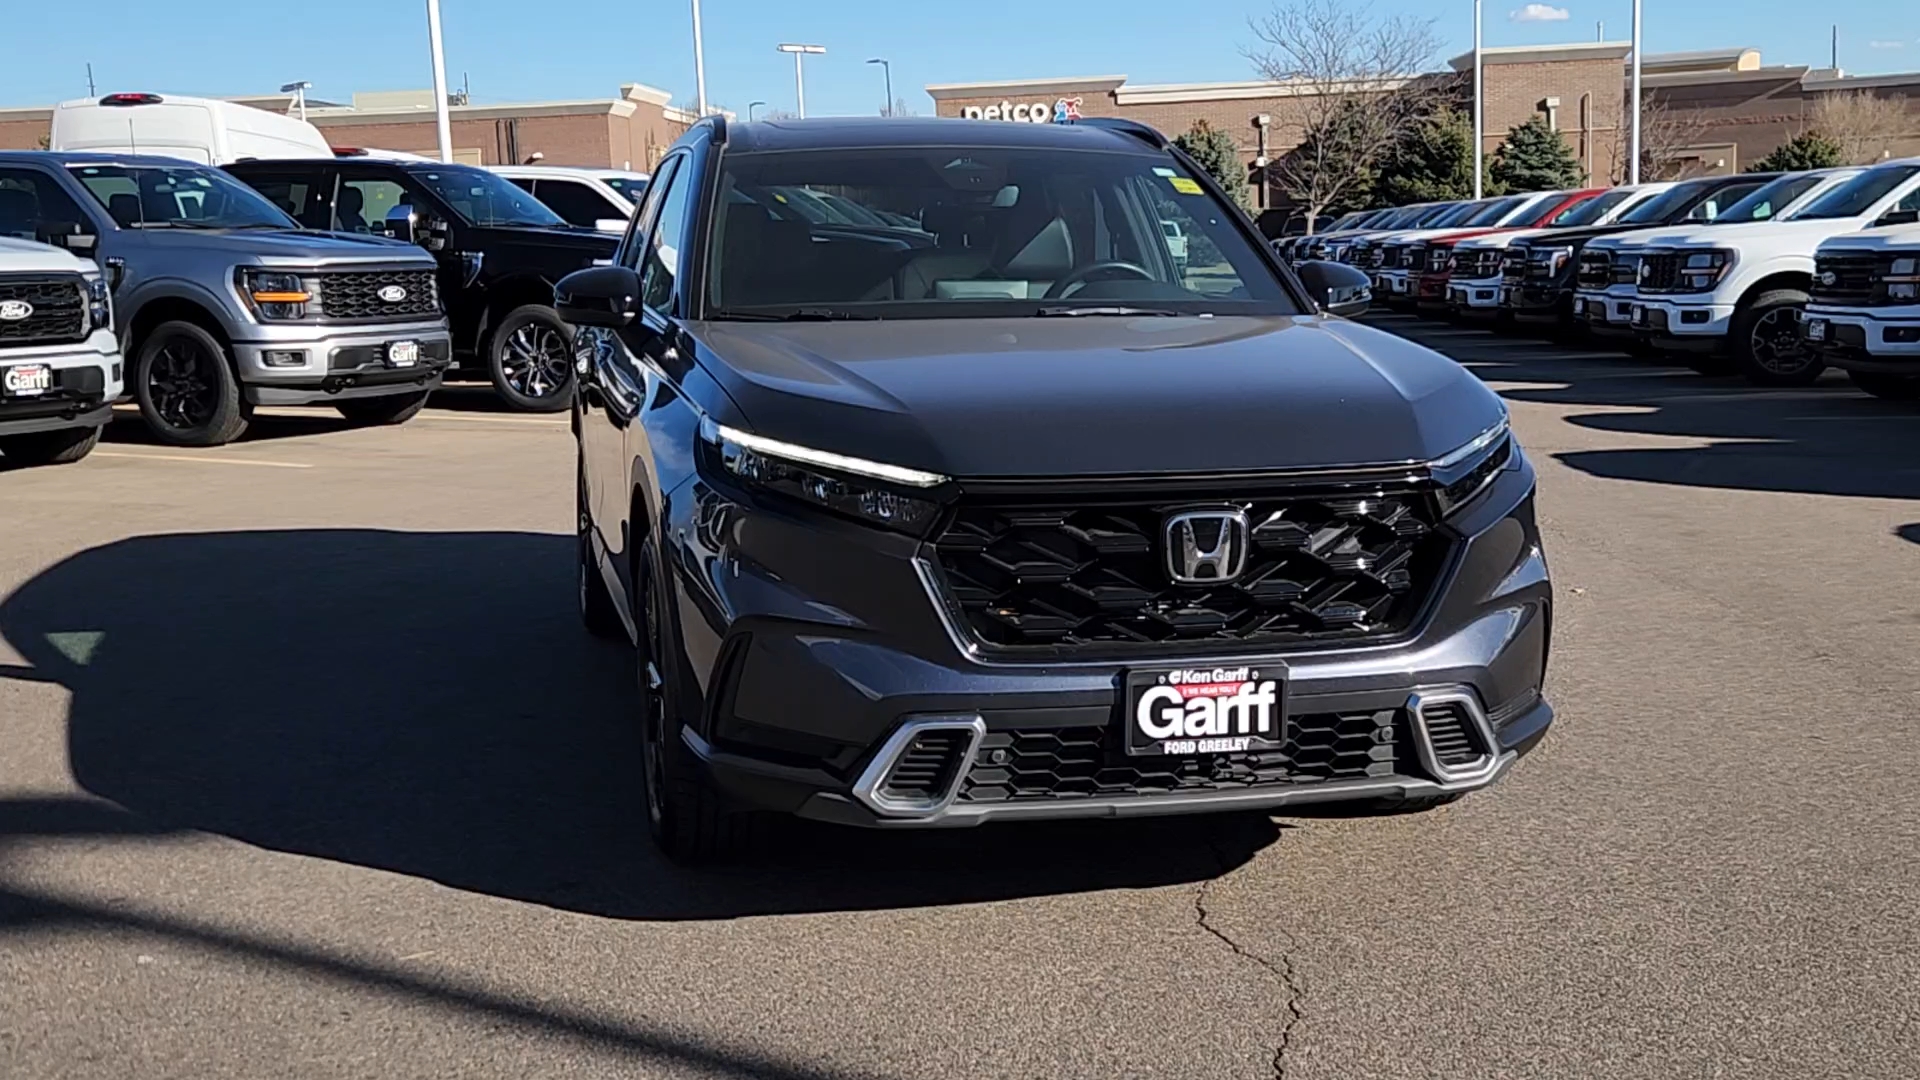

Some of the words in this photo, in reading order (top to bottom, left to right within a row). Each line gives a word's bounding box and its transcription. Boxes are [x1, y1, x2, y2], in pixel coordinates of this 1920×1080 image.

[964, 100, 1050, 123] petco
[5, 367, 50, 391] Garff
[1182, 670, 1211, 684] Ken
[1212, 667, 1249, 683] Garff
[1137, 681, 1276, 739] Garff
[1164, 741, 1196, 755] FORD
[1198, 738, 1250, 754] GREELEY
